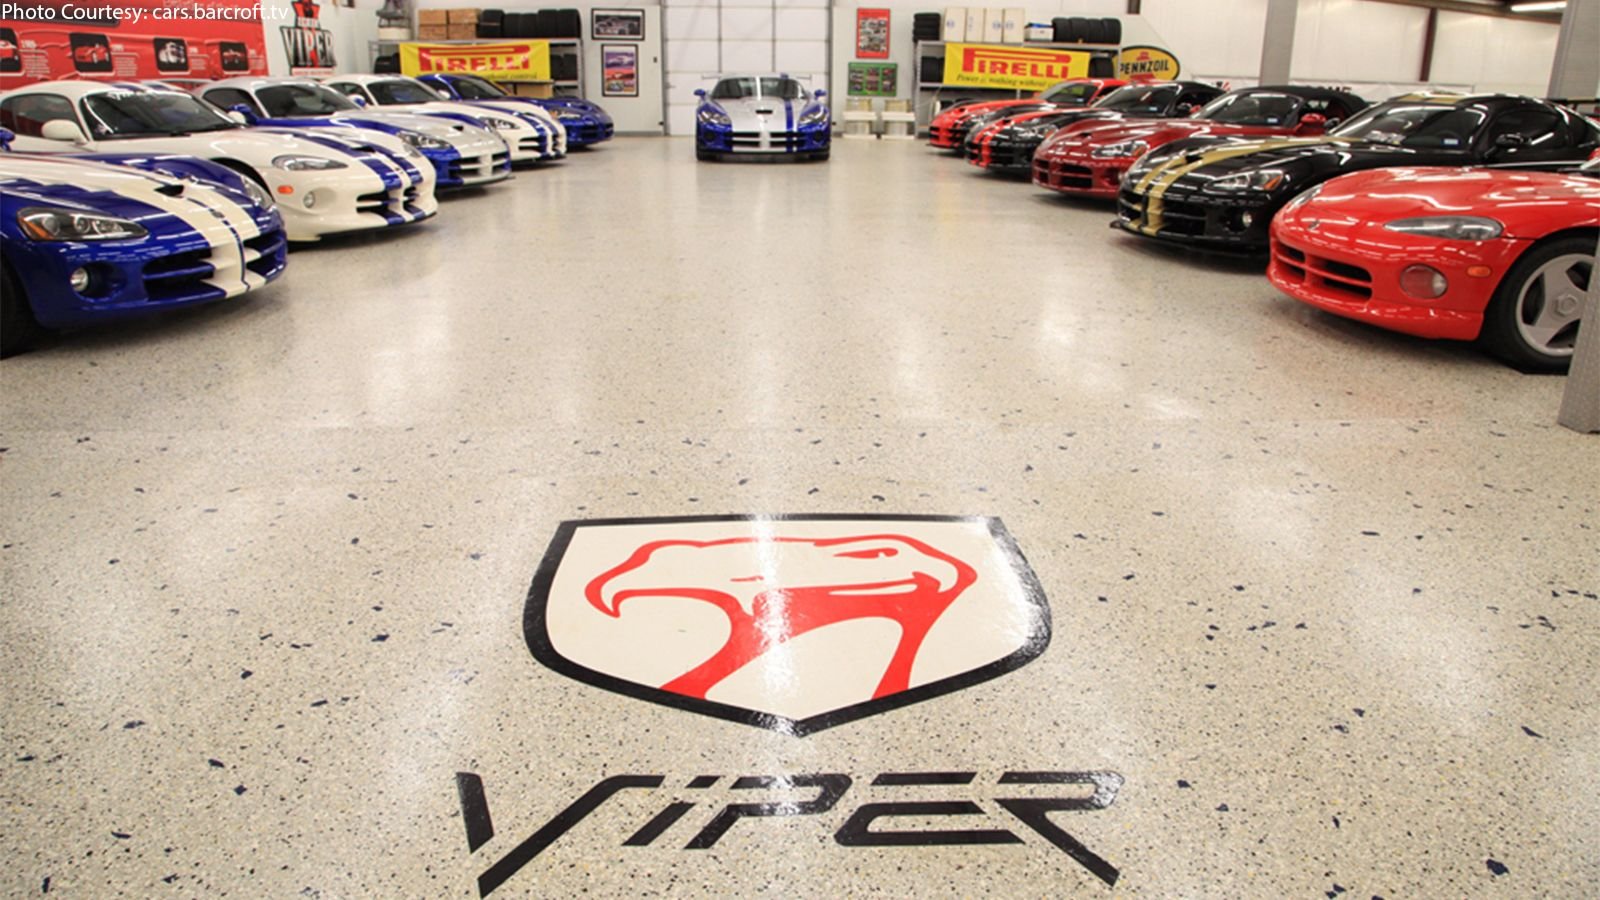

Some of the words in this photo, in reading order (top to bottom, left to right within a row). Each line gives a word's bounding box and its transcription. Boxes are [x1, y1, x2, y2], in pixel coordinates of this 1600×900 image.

[280, 27, 336, 67] VIPER
[418, 45, 531, 71] PIRELLI
[962, 47, 1072, 79] PIRELLI
[1120, 60, 1169, 75] PENNZOIL
[456, 771, 1125, 898] VIPER
